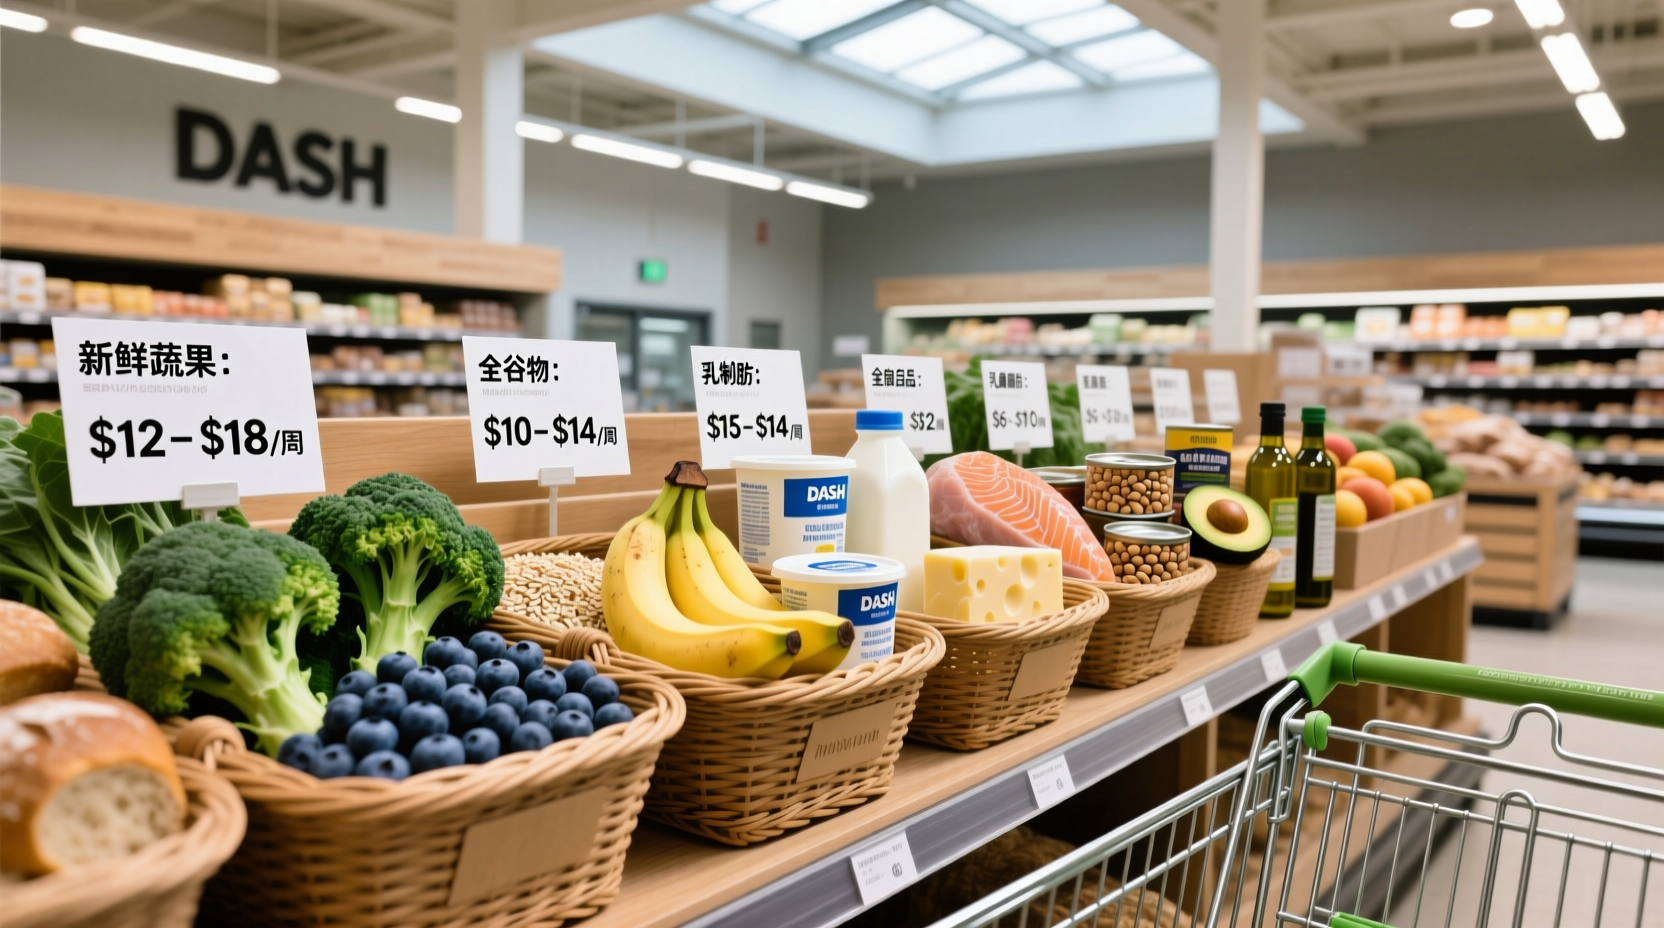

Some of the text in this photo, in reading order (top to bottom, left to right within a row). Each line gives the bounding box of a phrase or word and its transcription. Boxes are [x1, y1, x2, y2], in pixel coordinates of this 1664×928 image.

[174, 105, 389, 207] DASH
[78, 340, 230, 379] 新鲜蔬果：
[478, 354, 559, 384] 全谷物：
[807, 484, 845, 502] DASH
[860, 590, 895, 612] DASH
